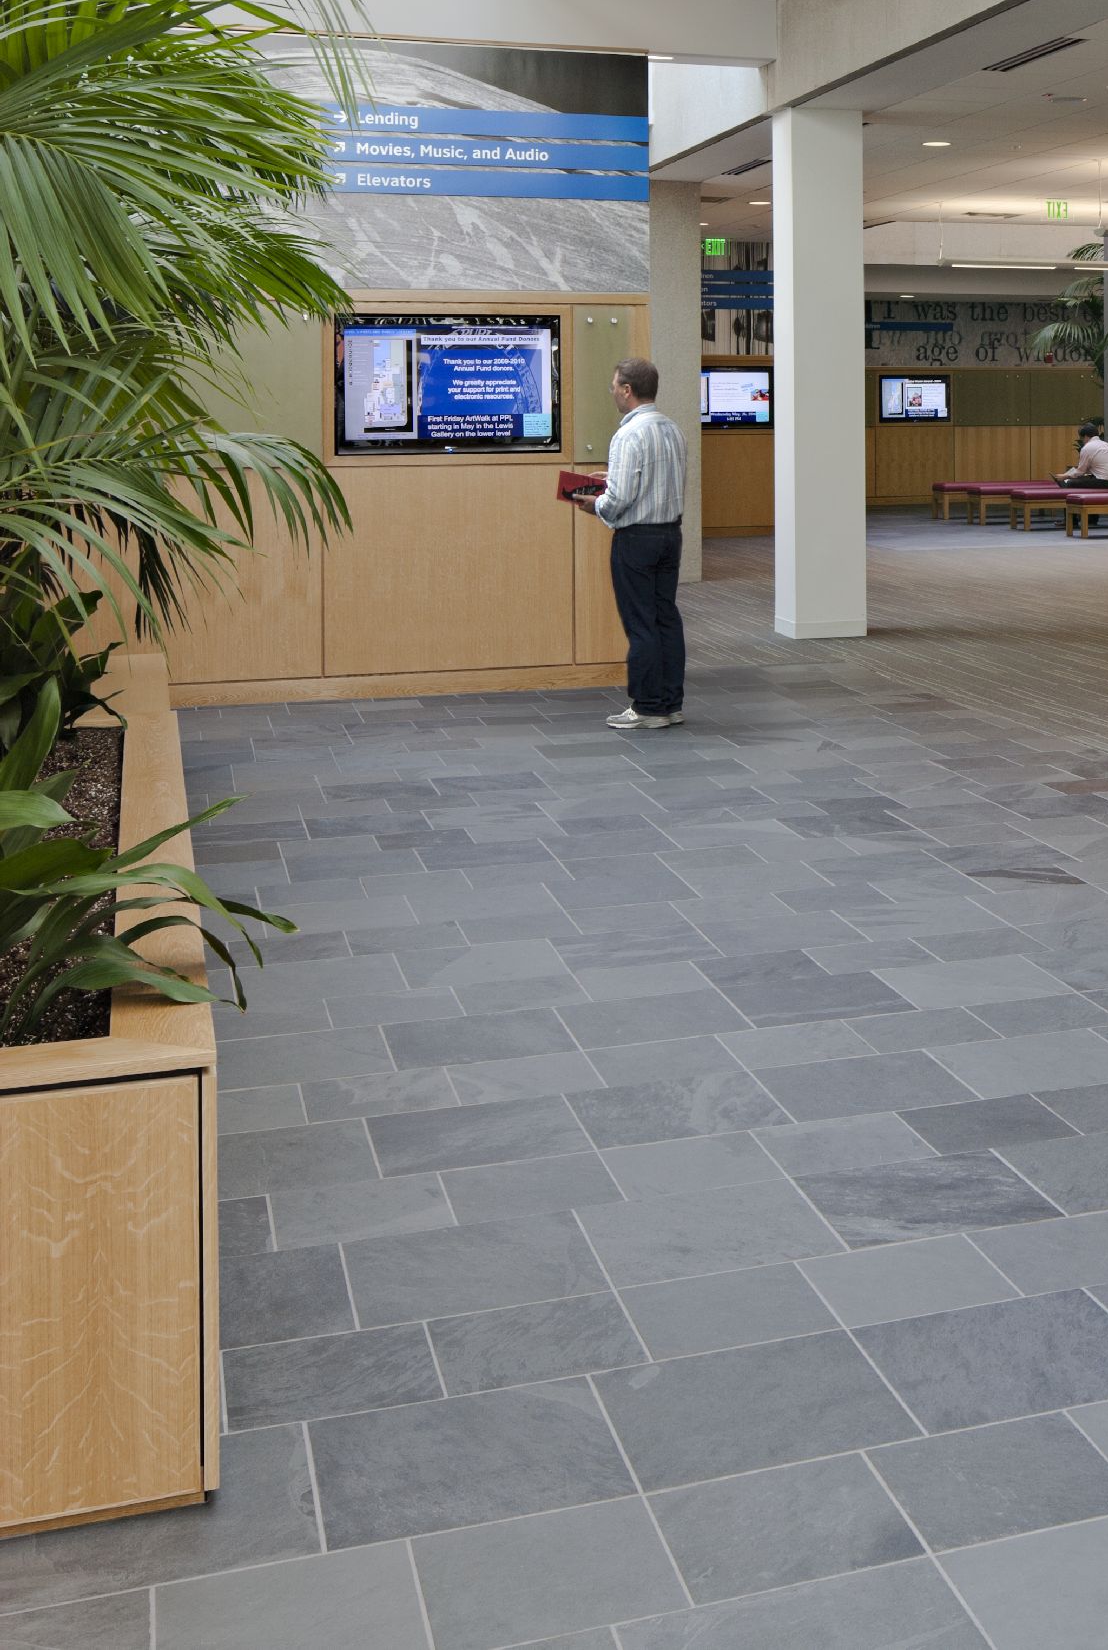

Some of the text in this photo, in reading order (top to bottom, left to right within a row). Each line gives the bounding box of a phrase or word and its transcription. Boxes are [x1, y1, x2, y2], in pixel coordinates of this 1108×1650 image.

[358, 112, 419, 129] Lending
[356, 142, 549, 161] Movies, Music, and Audio
[357, 174, 432, 189] Elevators
[705, 238, 725, 255] EXIT
[914, 302, 957, 321] was
[968, 301, 1009, 322] the
[1023, 302, 1070, 322] best
[915, 345, 959, 365] age
[975, 337, 1001, 362] of
[443, 415, 464, 423] Friday
[431, 431, 455, 439] Gallery
